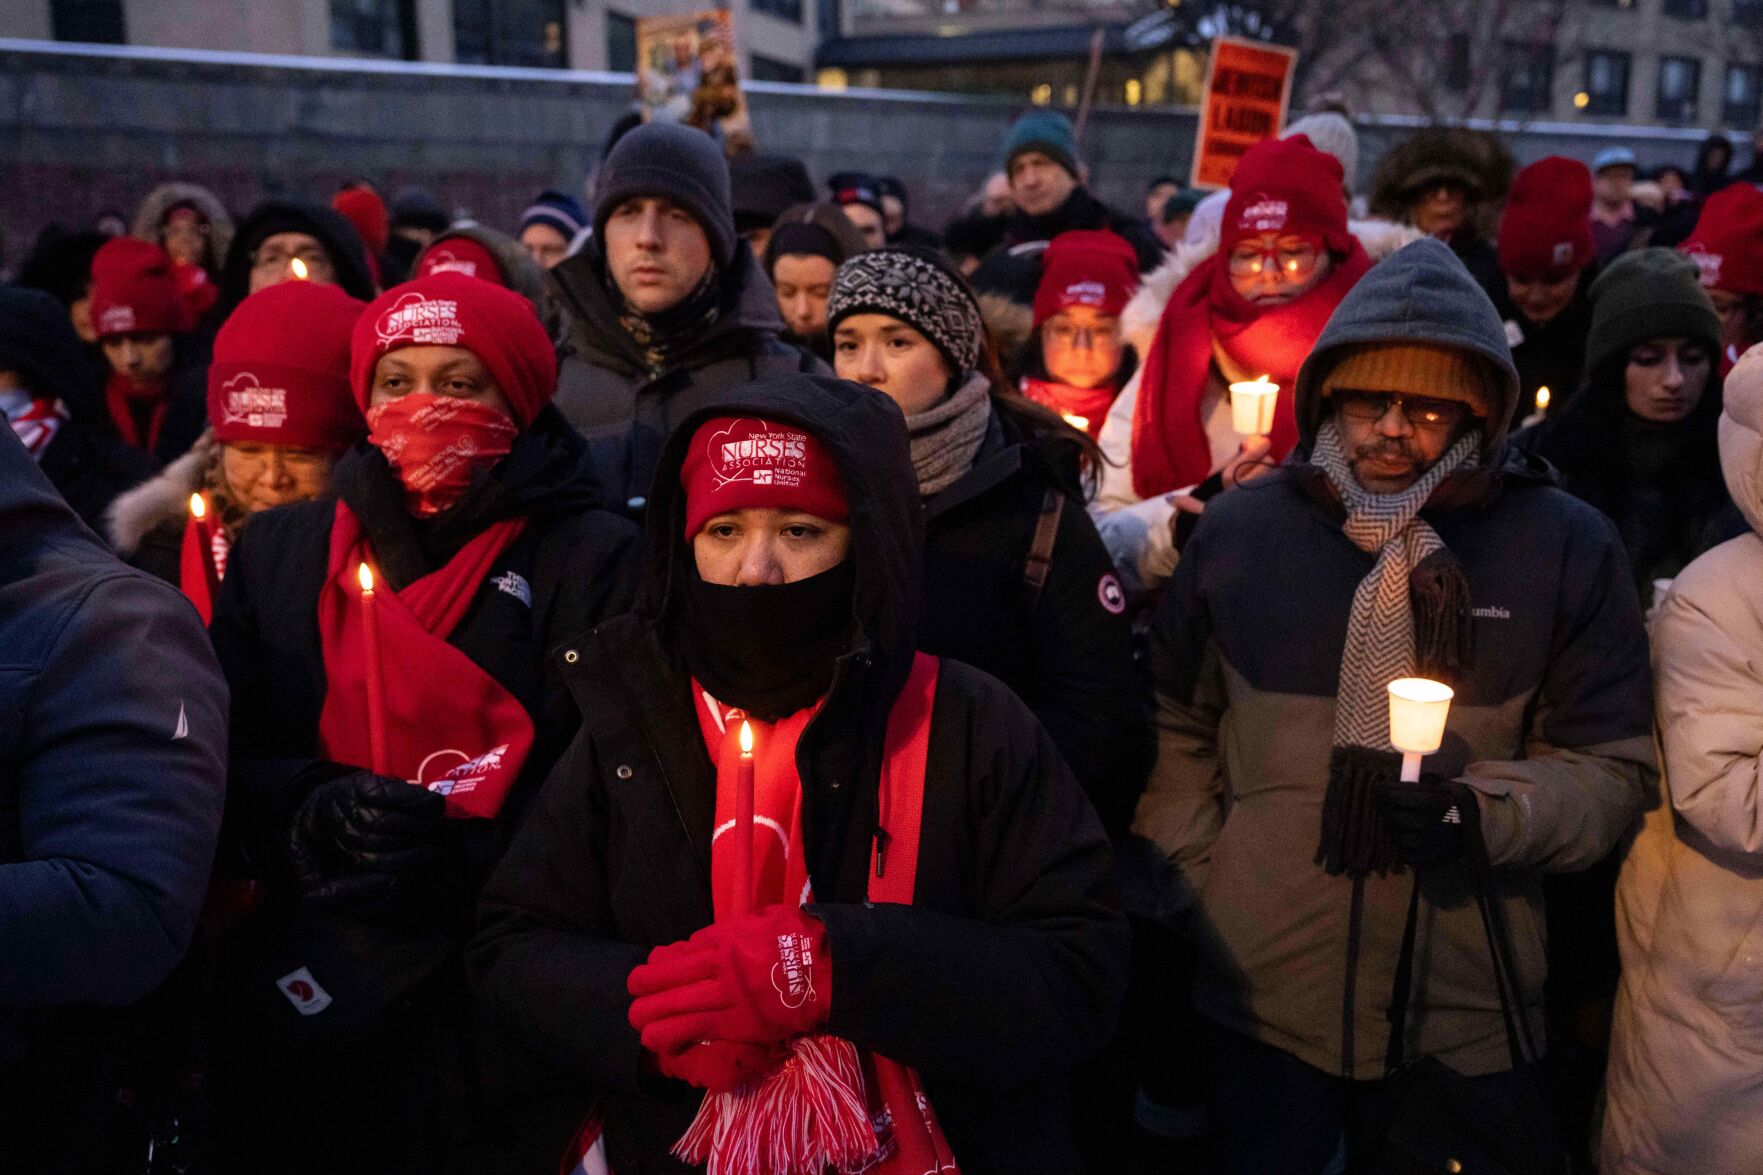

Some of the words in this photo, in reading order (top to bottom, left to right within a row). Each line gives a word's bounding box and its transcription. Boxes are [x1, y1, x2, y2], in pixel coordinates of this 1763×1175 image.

[388, 306, 458, 329] NURSES
[749, 432, 766, 440] New
[768, 432, 785, 440] York
[786, 432, 807, 441] State
[721, 439, 807, 463] NURSES
[721, 457, 806, 471] ASSOCIATION
[774, 467, 806, 477] National
[774, 473, 800, 482] Nurses
[1472, 605, 1510, 619] umbia
[781, 934, 802, 996] NURSES
